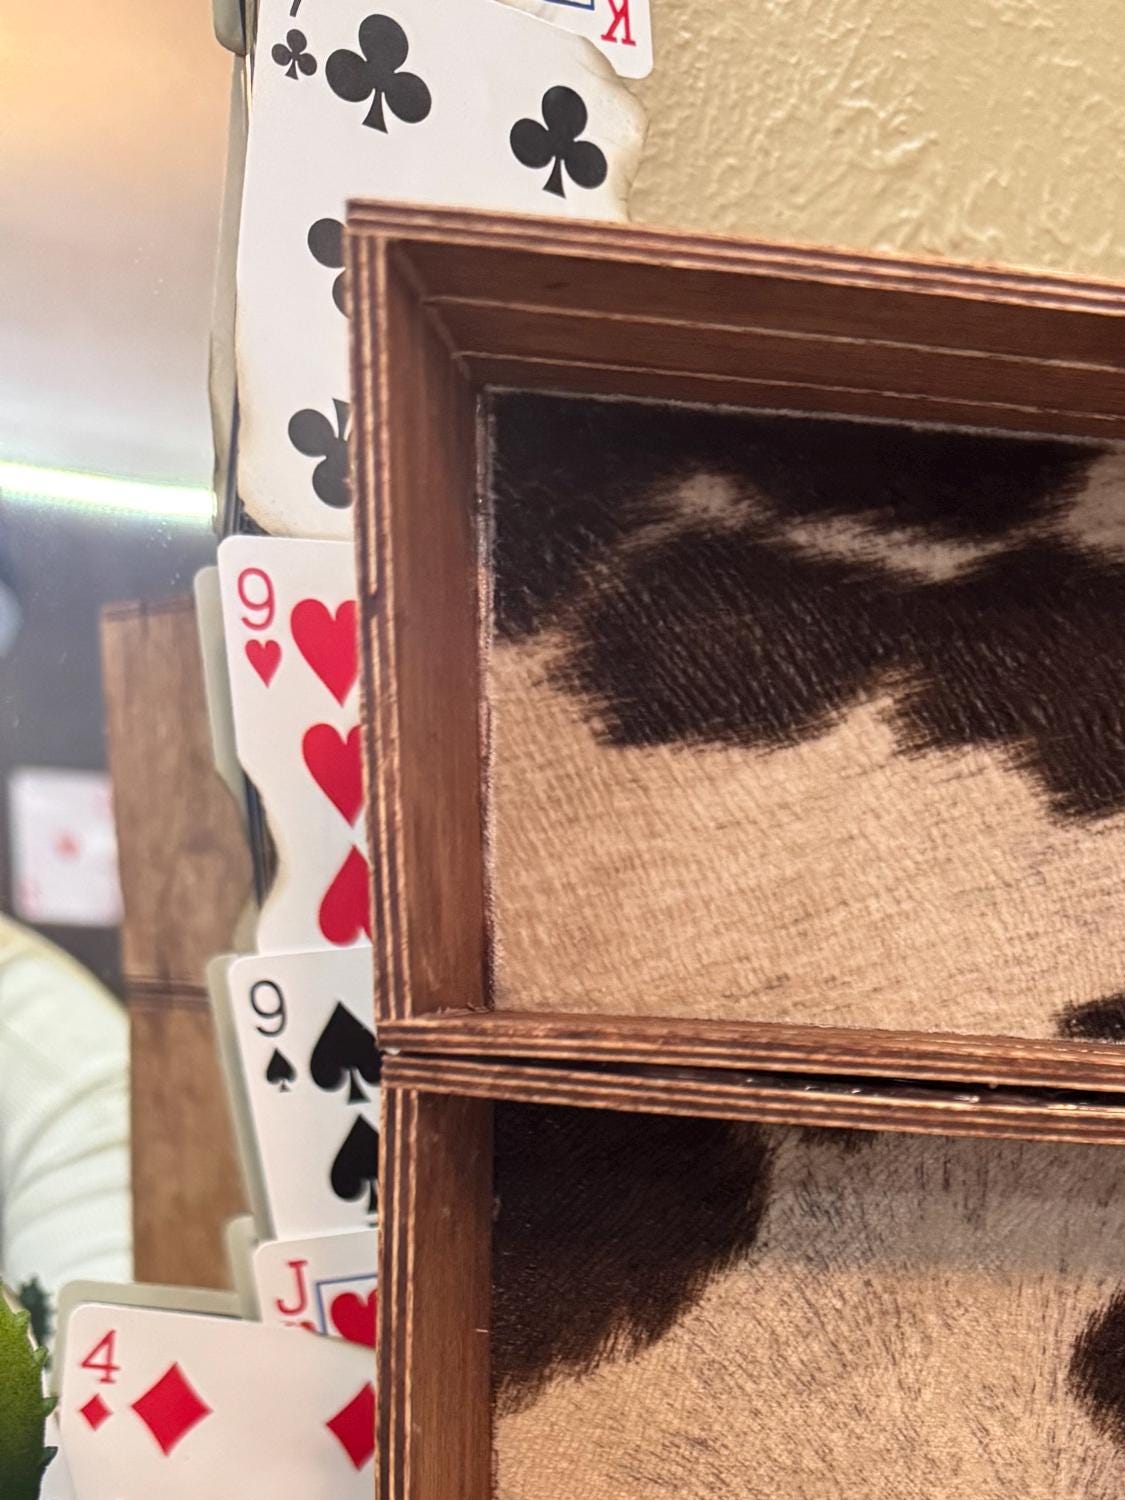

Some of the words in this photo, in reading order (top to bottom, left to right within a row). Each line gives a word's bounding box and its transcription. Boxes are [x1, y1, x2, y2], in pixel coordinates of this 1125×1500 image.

[237, 567, 275, 631] 9
[250, 979, 287, 1037] 9
[276, 1260, 307, 1315] J
[80, 1329, 120, 1384] 4
